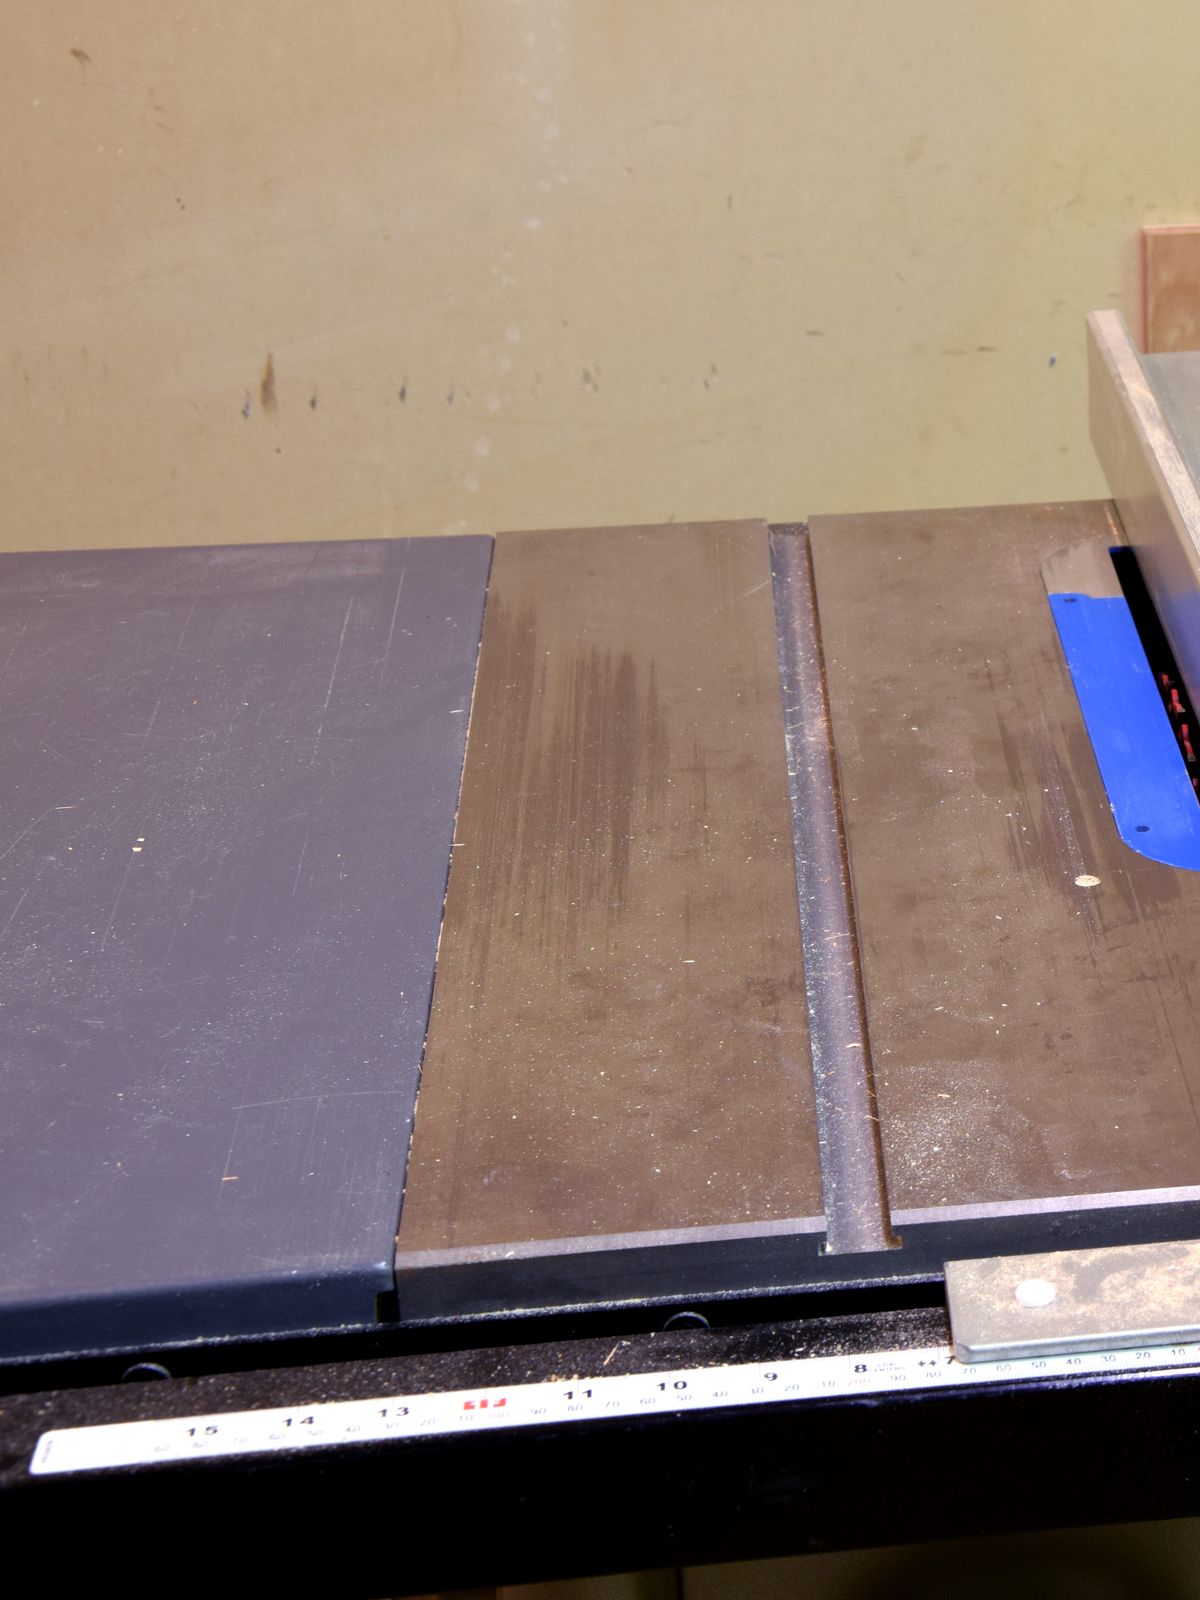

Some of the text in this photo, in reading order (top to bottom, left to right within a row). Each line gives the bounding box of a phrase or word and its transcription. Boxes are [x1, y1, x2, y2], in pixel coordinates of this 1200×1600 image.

[1136, 1352, 1151, 1360] 20
[1171, 1348, 1186, 1356] 10
[185, 1425, 219, 1437] 15
[282, 1415, 315, 1428] 14
[376, 1406, 410, 1418] 13
[563, 1389, 593, 1400] 11
[656, 1380, 688, 1392] 10
[763, 1372, 778, 1381] 9
[853, 1364, 868, 1374] 8
